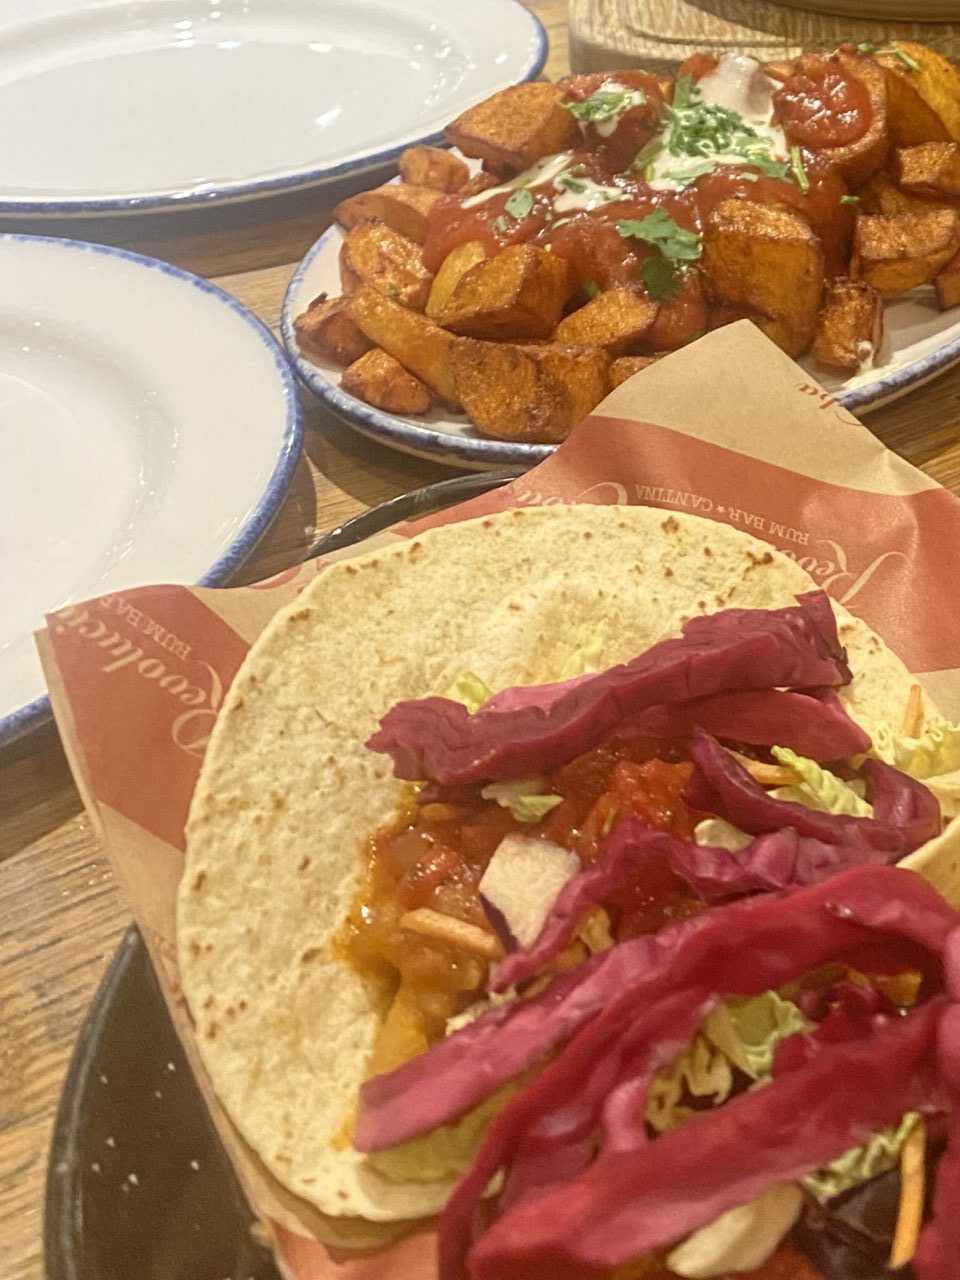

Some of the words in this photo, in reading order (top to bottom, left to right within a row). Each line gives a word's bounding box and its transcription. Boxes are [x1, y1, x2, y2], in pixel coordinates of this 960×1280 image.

[635, 484, 714, 512] CANTINA
[728, 507, 766, 530] BAR
[768, 523, 810, 546] RUM
[143, 618, 193, 661] RUM
